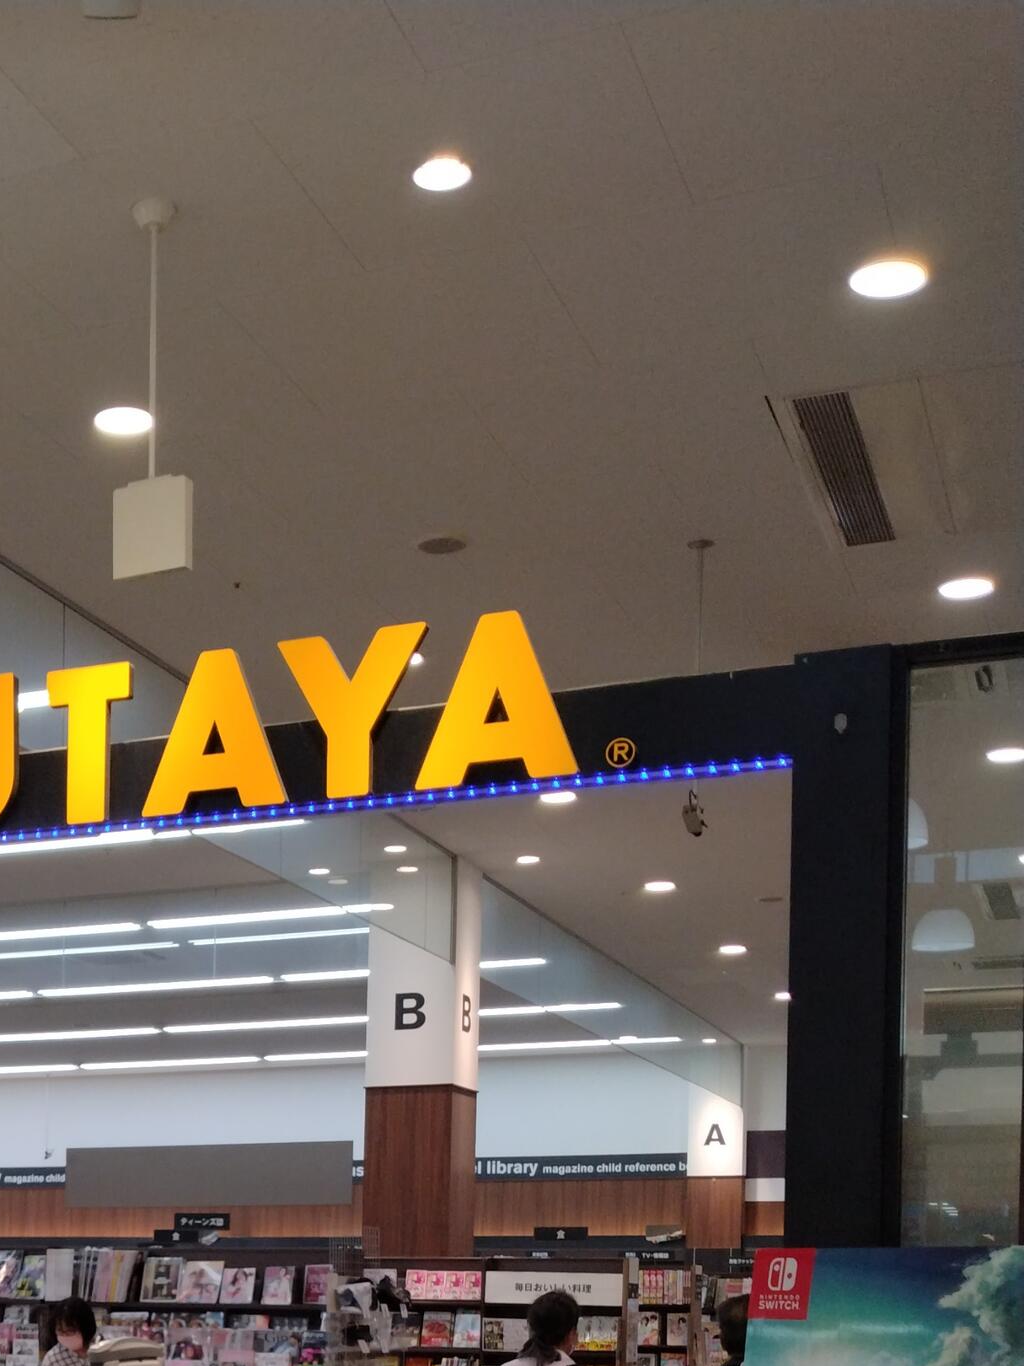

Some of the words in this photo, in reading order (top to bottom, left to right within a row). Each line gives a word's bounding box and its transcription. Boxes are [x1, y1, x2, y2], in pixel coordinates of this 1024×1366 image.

[394, 992, 427, 1031] B
[461, 993, 472, 1033] B
[703, 1123, 727, 1147] A
[487, 1160, 538, 1177] library
[542, 1164, 594, 1175] magazine
[596, 1162, 622, 1173] child
[624, 1161, 676, 1173] reference
[3, 1174, 44, 1185] magazine
[758, 1300, 800, 1311] SWITCH
